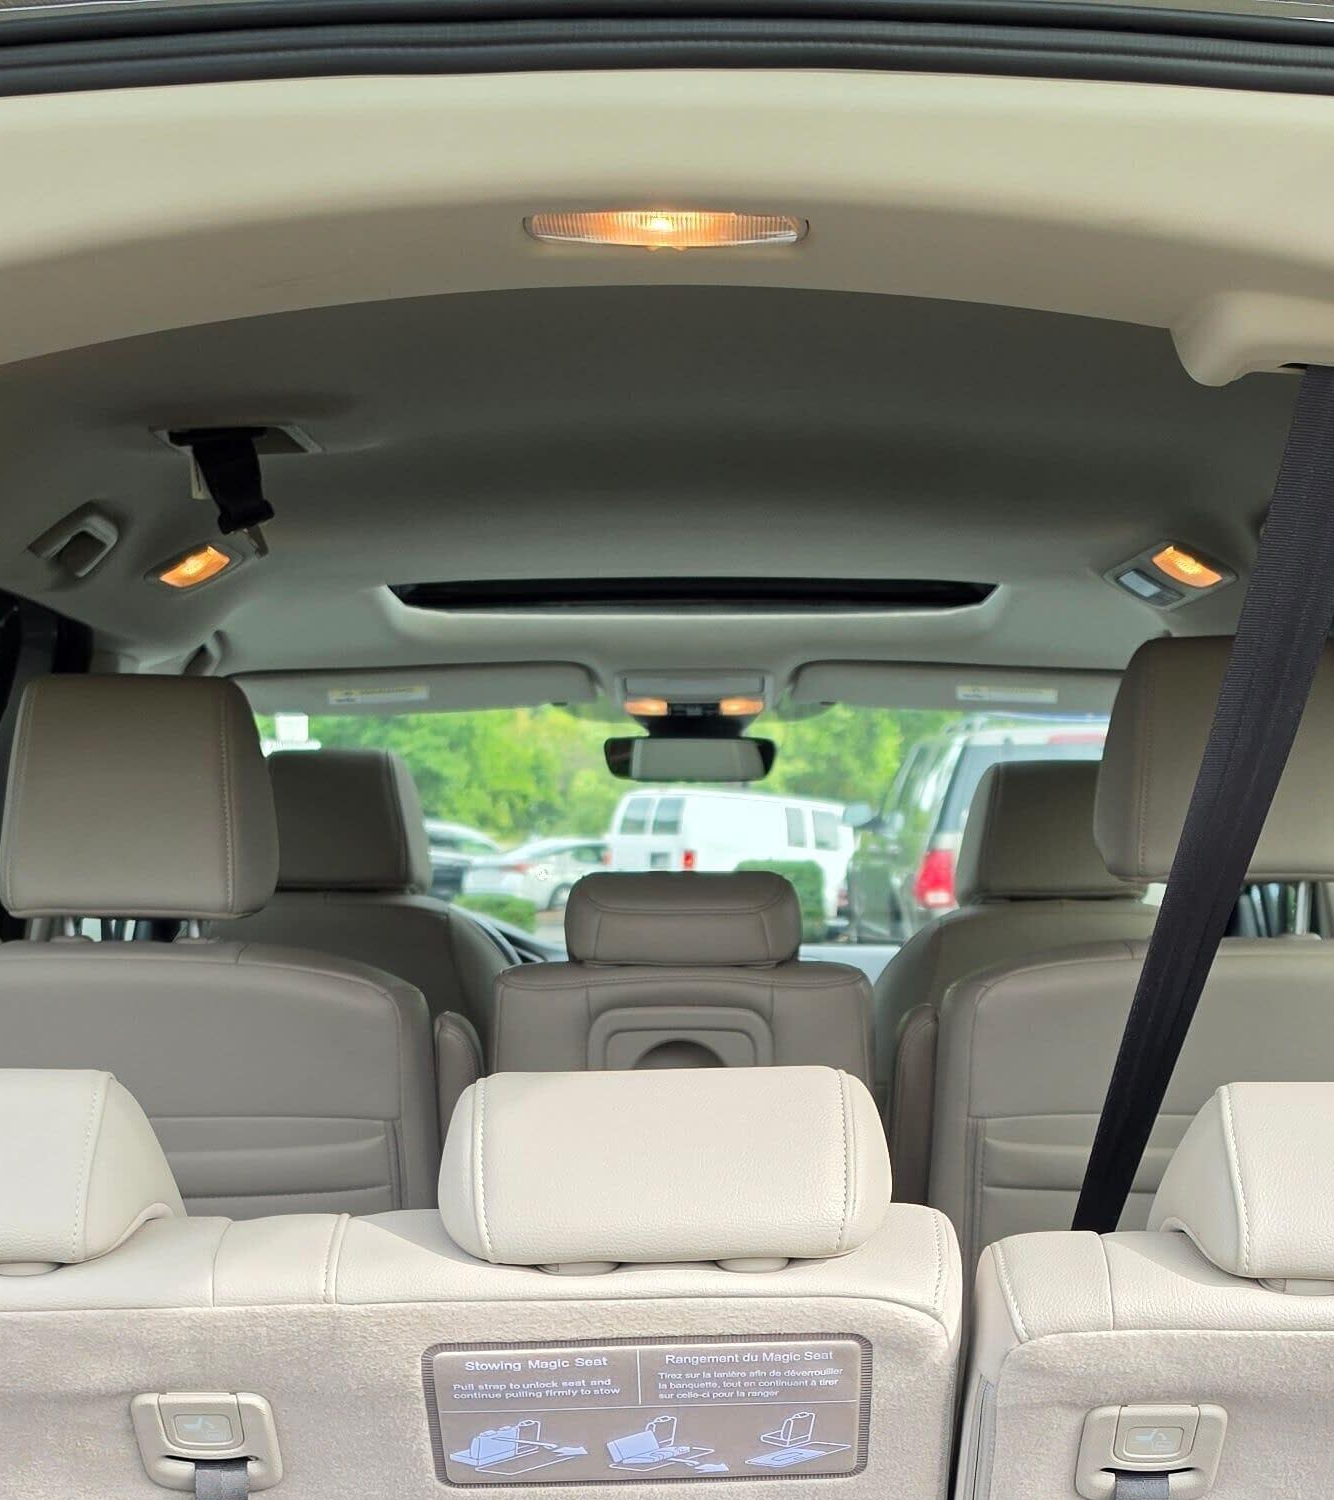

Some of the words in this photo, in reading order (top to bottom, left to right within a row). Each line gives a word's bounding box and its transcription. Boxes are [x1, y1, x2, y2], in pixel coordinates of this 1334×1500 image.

[665, 1354, 739, 1365] Rangement
[743, 1353, 759, 1362] du
[762, 1352, 801, 1362] Magic
[804, 1351, 834, 1361] Seat
[465, 1361, 522, 1371] Stowing
[528, 1359, 570, 1370] Magic
[575, 1357, 608, 1367] Seat
[658, 1372, 682, 1380] Tirez
[769, 1369, 781, 1377] de
[453, 1383, 474, 1391] Pull
[478, 1383, 506, 1392] strap
[523, 1380, 558, 1389] unlock
[590, 1378, 612, 1386] and
[759, 1379, 808, 1387] continuant
[819, 1378, 839, 1386] tirer
[505, 1391, 543, 1400] pulling
[545, 1389, 577, 1397] firmly
[748, 1390, 779, 1398] ranger
